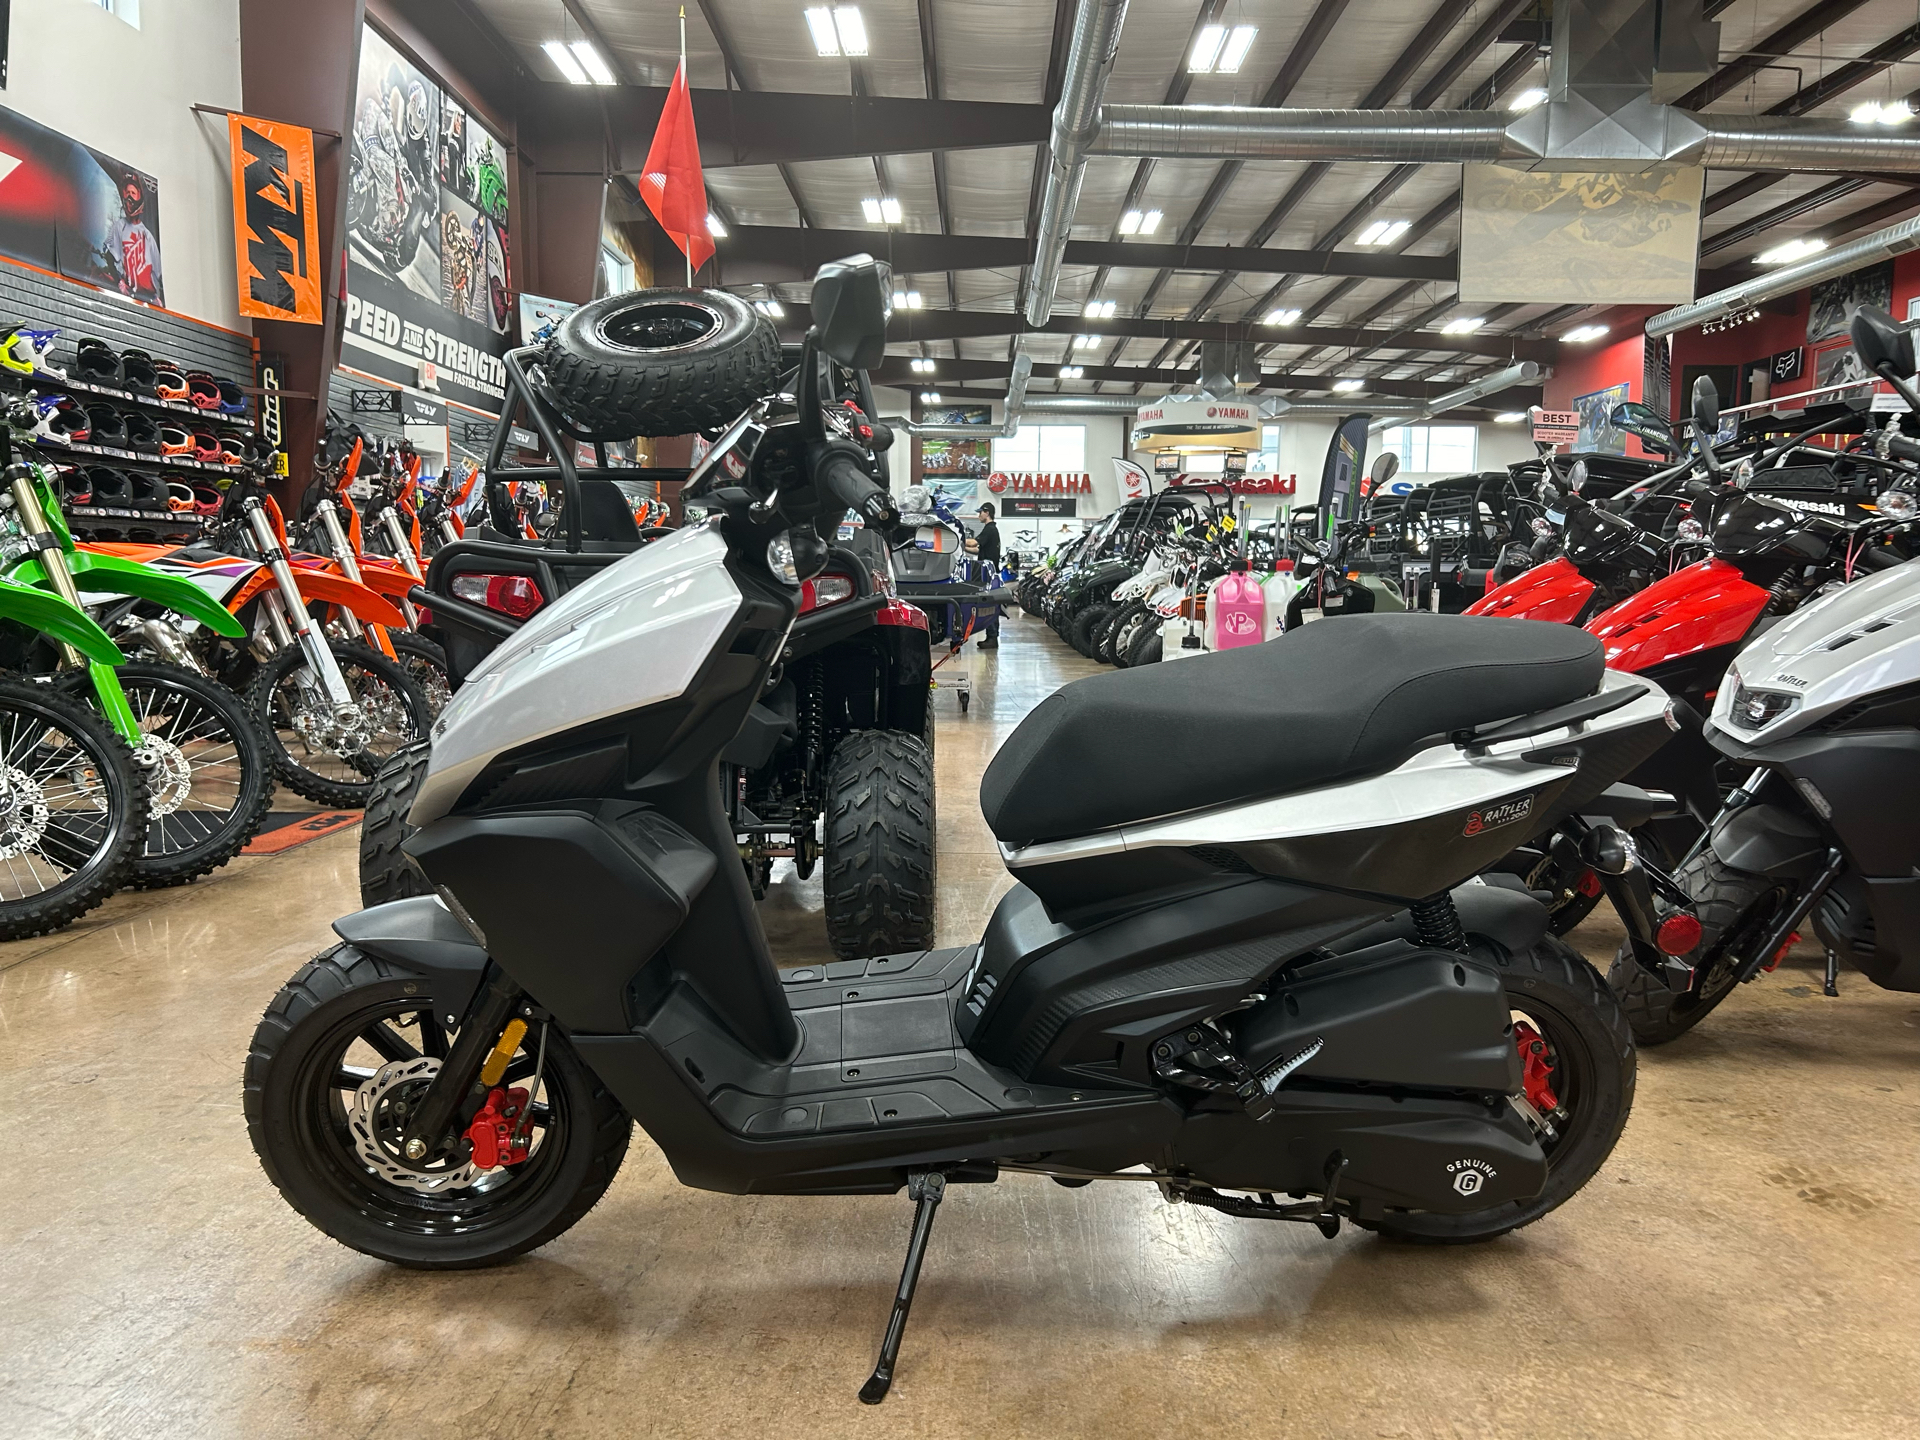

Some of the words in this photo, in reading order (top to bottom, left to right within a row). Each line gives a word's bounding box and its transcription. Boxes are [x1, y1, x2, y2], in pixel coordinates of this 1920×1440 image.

[241, 124, 307, 313] KTM
[345, 292, 400, 346] PEED
[403, 330, 423, 347] AND
[424, 328, 507, 387] STRENGTH
[413, 400, 437, 417] FLY
[1217, 407, 1250, 420] YAMAHA
[1542, 413, 1572, 424] BEST
[513, 431, 531, 444] FLY
[1641, 426, 1669, 442] FINANCING
[1011, 472, 1092, 494] YAMAHA
[1757, 493, 1846, 517] awasaki
[1226, 611, 1248, 634] VP
[1484, 799, 1531, 822] RATTLER
[299, 814, 357, 831] KTM
[1446, 1158, 1497, 1179] GENUINE
